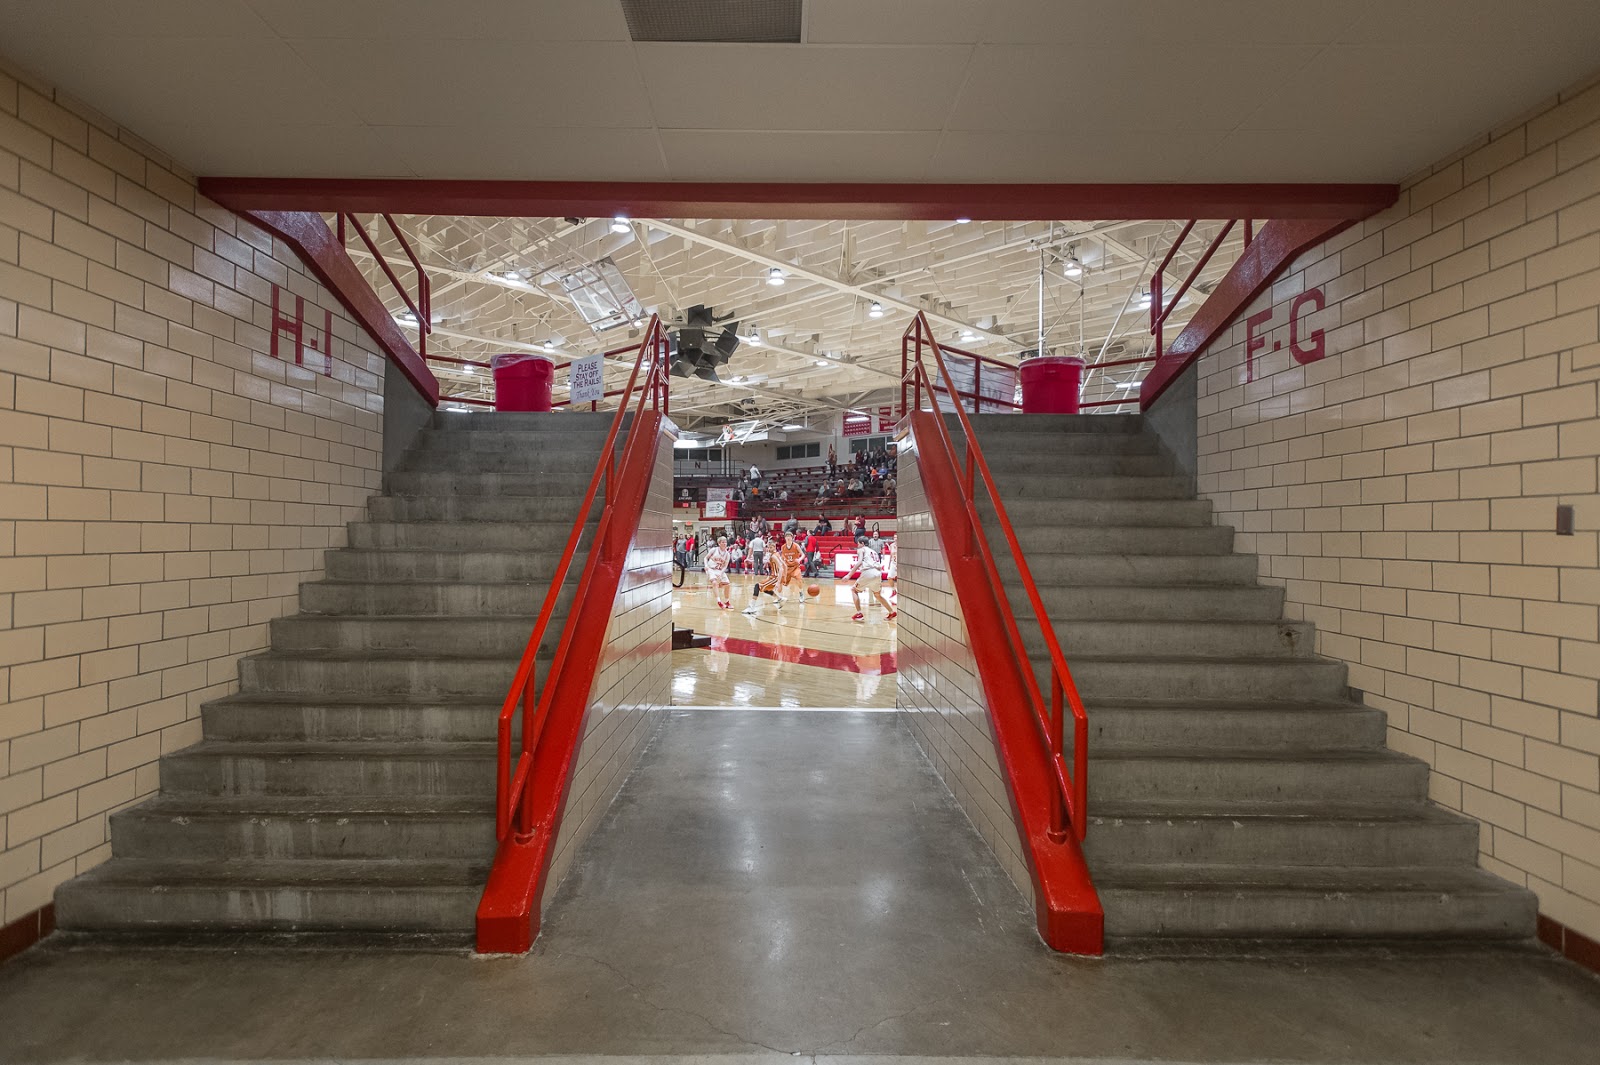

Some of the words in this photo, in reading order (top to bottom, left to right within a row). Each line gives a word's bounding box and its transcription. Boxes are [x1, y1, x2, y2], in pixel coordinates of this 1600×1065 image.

[577, 361, 598, 373] PLEASE
[575, 372, 588, 381] STAY
[588, 370, 599, 378] OFF
[573, 380, 584, 389] THE
[694, 461, 701, 469] N
